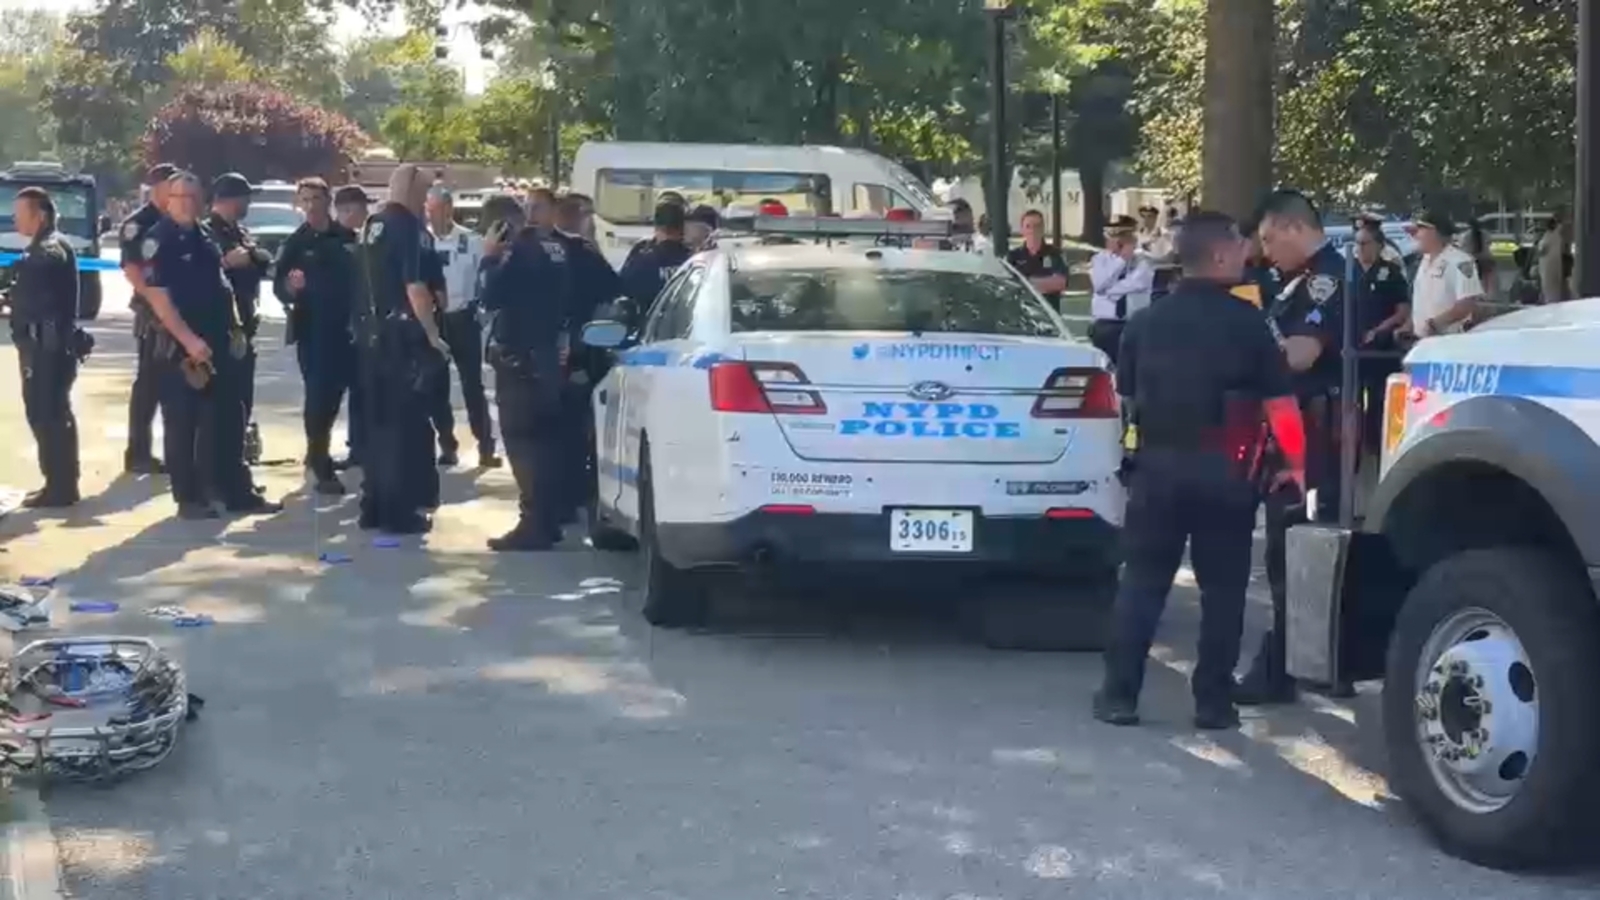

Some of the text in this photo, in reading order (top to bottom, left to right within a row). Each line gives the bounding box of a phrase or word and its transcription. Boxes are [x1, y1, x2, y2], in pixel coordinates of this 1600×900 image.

[1427, 361, 1501, 394] POLICE
[862, 402, 999, 419] NYPD
[839, 420, 1020, 438] POLICE
[899, 519, 949, 541] 3306
